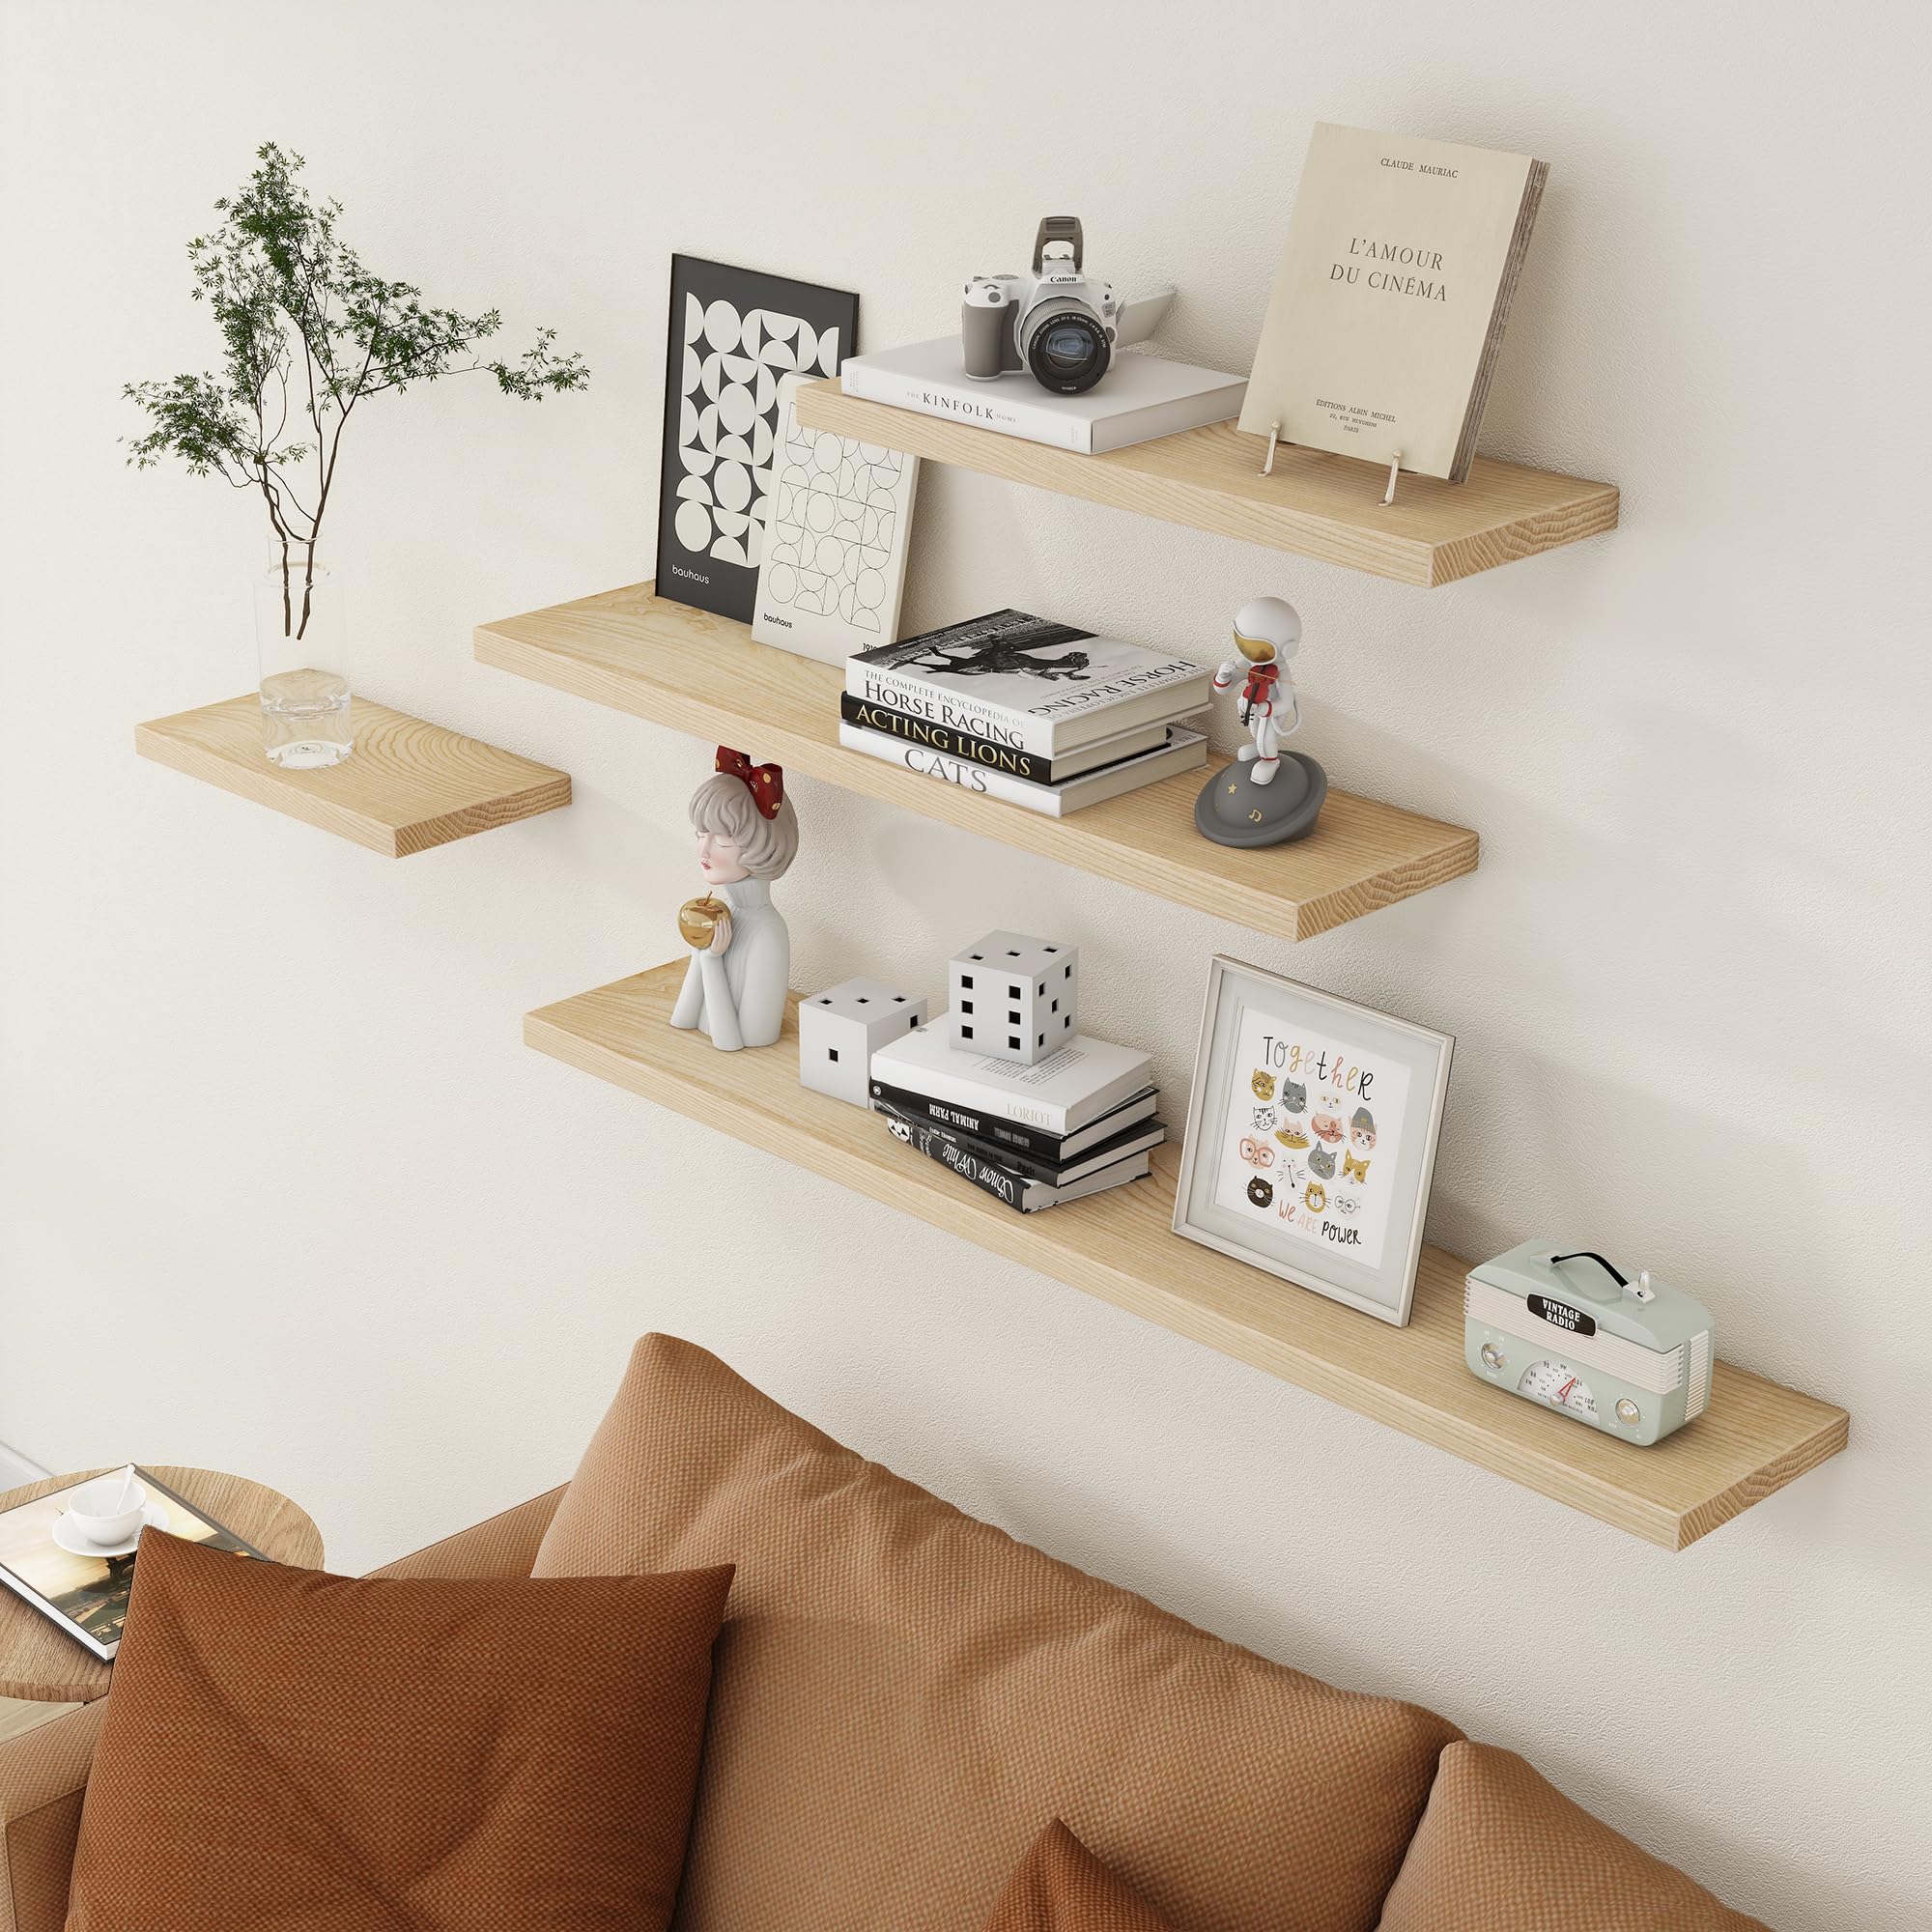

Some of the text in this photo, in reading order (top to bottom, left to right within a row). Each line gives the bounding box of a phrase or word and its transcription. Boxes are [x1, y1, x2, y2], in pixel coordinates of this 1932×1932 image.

[1380, 157, 1459, 179] CLAUDE MAURIAC
[1349, 237, 1444, 271] L'AMOUR
[1329, 263, 1448, 302] DU CINÉMA
[923, 393, 994, 420] KINFOLK
[1349, 407, 1368, 416] ALBIN
[1371, 412, 1397, 423] MICHEL
[671, 564, 710, 584] bauhaus
[763, 612, 793, 629] bauhaus
[1116, 661, 1197, 687] HORSE
[866, 670, 883, 682] THE
[886, 674, 934, 698] COMPLETE
[938, 693, 1009, 722] ENCYCLOPEDIA
[1028, 685, 1122, 716] RACING
[865, 680, 1025, 750] HORSE RACING
[856, 704, 1032, 776] ACTING LIONS
[904, 748, 988, 793] CATS
[928, 1103, 980, 1131] ANIMAL FARM
[942, 1143, 977, 1180] White
[979, 1166, 1014, 1204] Snow
[1542, 1298, 1580, 1322] VINTAGE
[1546, 1311, 1575, 1330] RADIO
